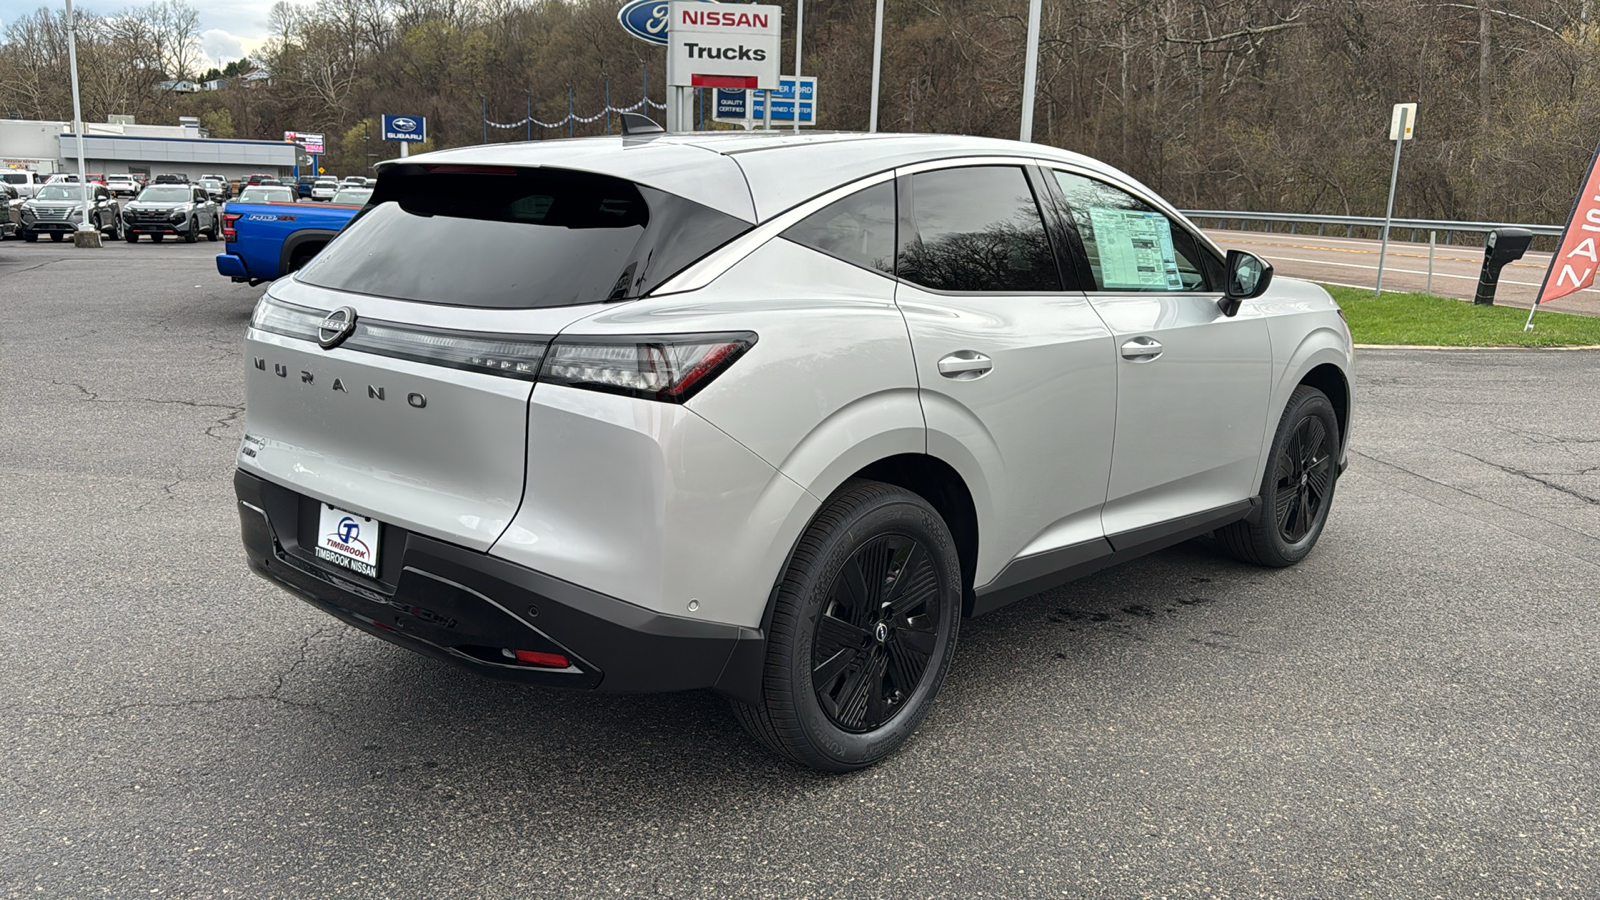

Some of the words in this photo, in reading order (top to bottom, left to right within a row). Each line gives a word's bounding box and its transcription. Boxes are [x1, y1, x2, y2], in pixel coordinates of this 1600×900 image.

[682, 10, 768, 28] NISSAN
[683, 42, 767, 62] Trucks
[387, 132, 422, 140] SUBARU
[253, 356, 427, 409] MURANO
[326, 538, 367, 559] TIMBROOK
[314, 546, 350, 568] TIMBROOK
[350, 559, 376, 578] NISSAN
